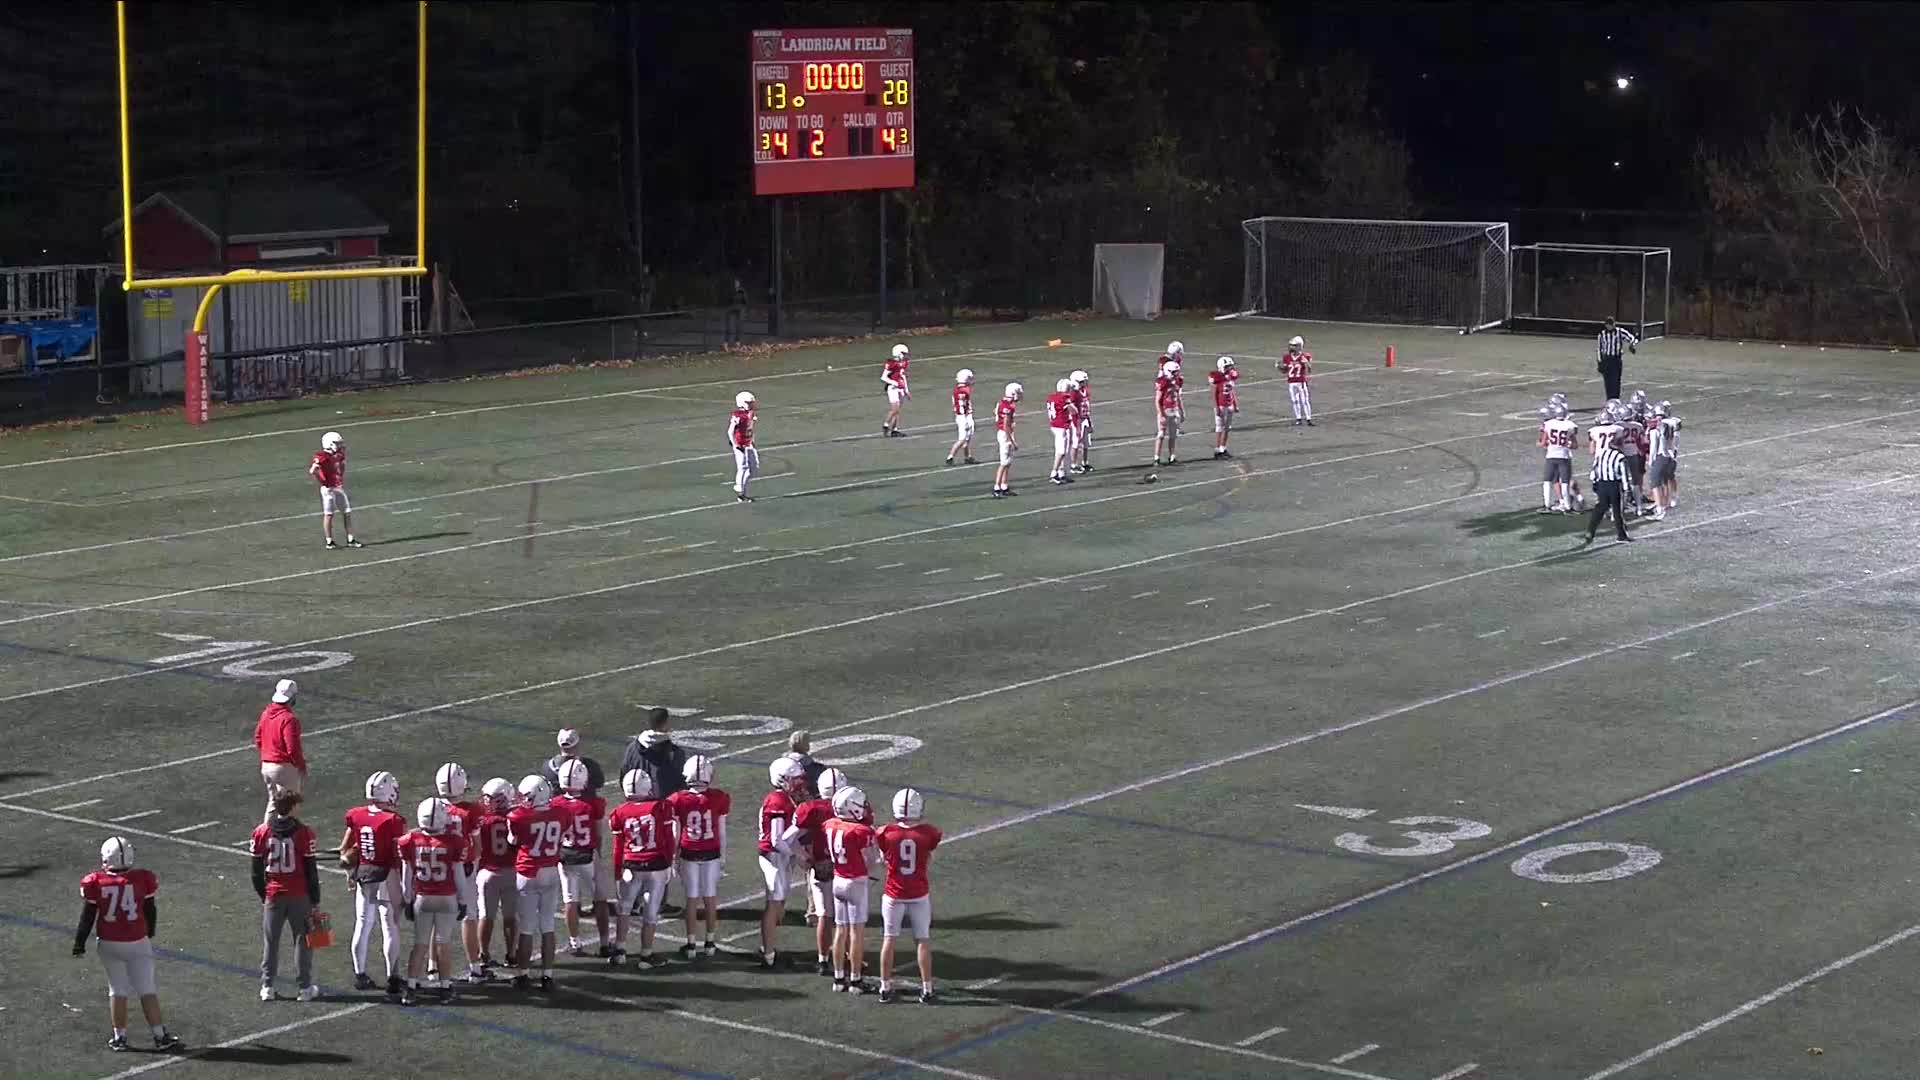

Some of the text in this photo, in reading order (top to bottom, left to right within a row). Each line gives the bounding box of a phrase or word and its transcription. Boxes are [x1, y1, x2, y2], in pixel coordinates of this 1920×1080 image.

[781, 37, 887, 51] LANDRIGAN FIELD
[806, 63, 864, 90] 00:00
[880, 63, 910, 77] GUEST
[767, 83, 787, 109] 13
[883, 80, 908, 105] 28
[759, 116, 788, 130] DOWN
[796, 114, 824, 128] TO GO
[844, 113, 877, 127] CALL ON
[762, 133, 770, 150] 3
[774, 132, 788, 156] 4
[811, 129, 824, 156] 2
[882, 128, 895, 151] 4
[900, 128, 908, 144] 3
[529, 821, 562, 856] 79
[265, 838, 296, 873] 20
[415, 846, 448, 881] 55
[900, 838, 917, 875] 9
[102, 884, 138, 922] 74
